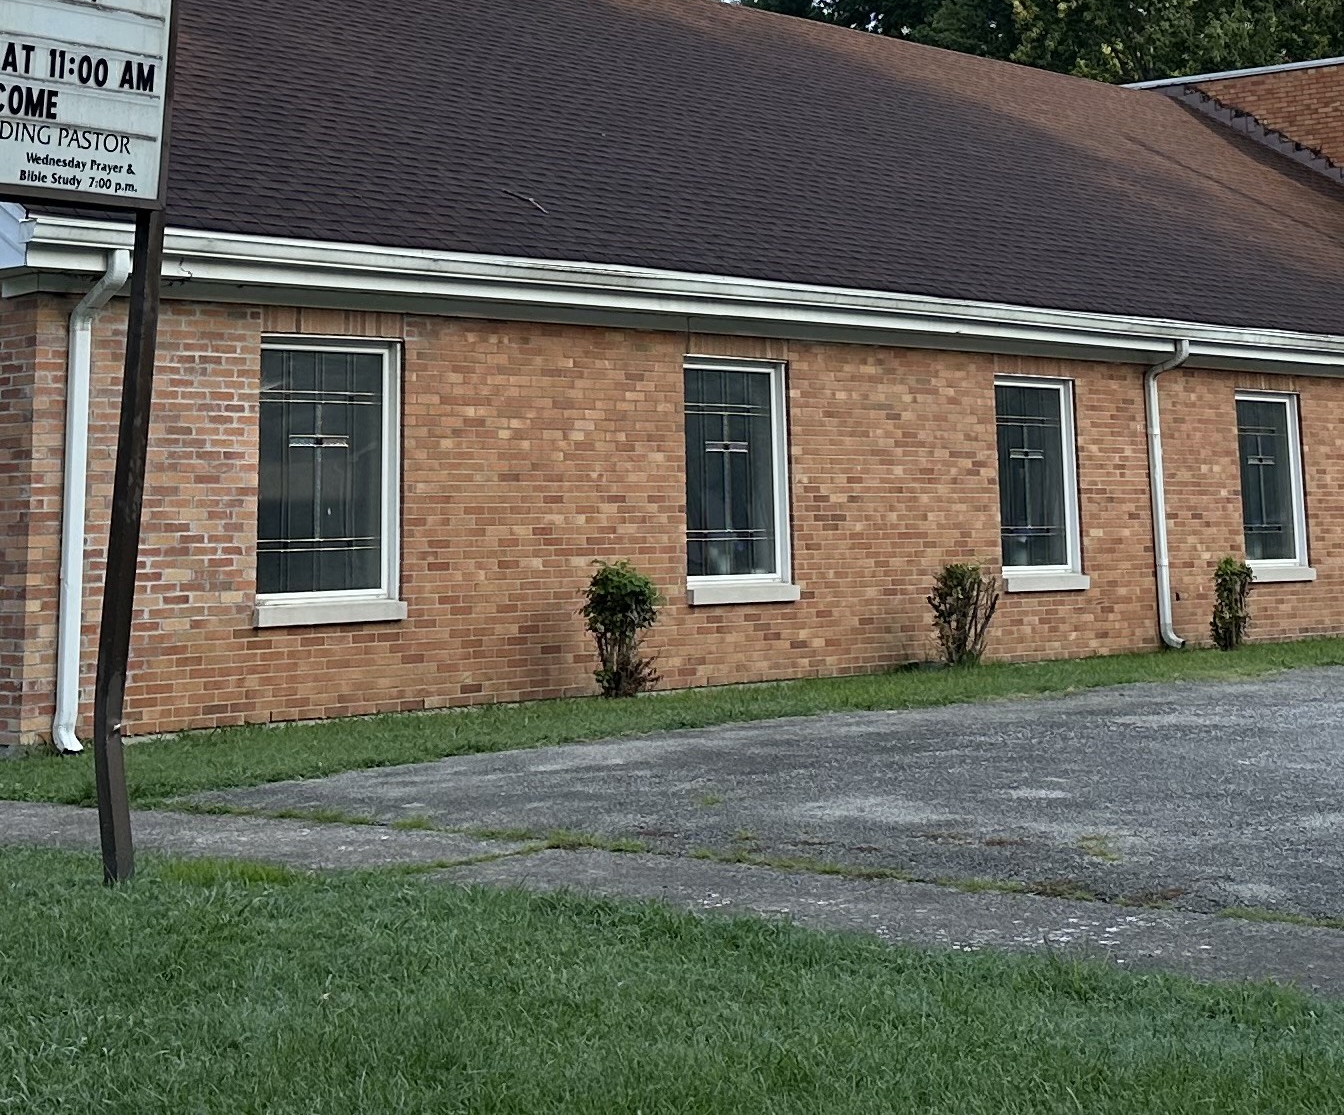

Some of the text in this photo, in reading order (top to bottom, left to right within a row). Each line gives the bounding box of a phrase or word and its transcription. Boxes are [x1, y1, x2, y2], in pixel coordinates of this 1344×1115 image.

[2, 42, 35, 74] AT
[49, 48, 108, 87] 11:00
[119, 60, 155, 92] AM
[58, 127, 131, 154] PASTOR
[27, 152, 136, 176] Wednesday Prayer &
[19, 169, 138, 193] Bible Study 7:00 p.m.
